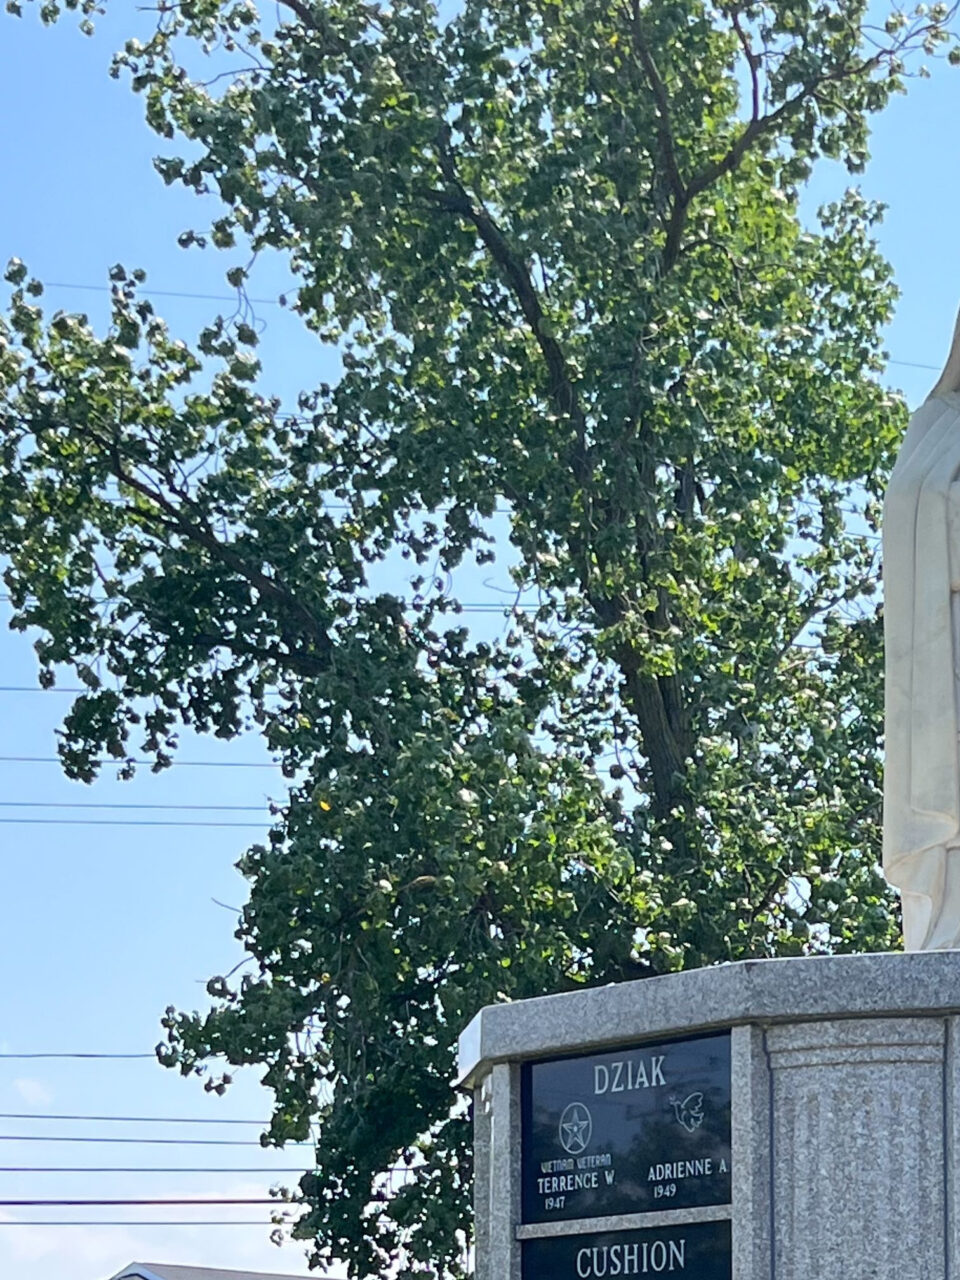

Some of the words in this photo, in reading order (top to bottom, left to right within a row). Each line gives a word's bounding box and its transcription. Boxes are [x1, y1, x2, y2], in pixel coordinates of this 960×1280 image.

[594, 1056, 667, 1095] DZIAK
[577, 1153, 612, 1169] VETERAN
[648, 1158, 713, 1181] ADRIENNE
[537, 1172, 599, 1194] TERRENCE
[654, 1184, 677, 1198] 1949
[544, 1196, 565, 1211] 1947
[576, 1239, 686, 1279] CUSHION
